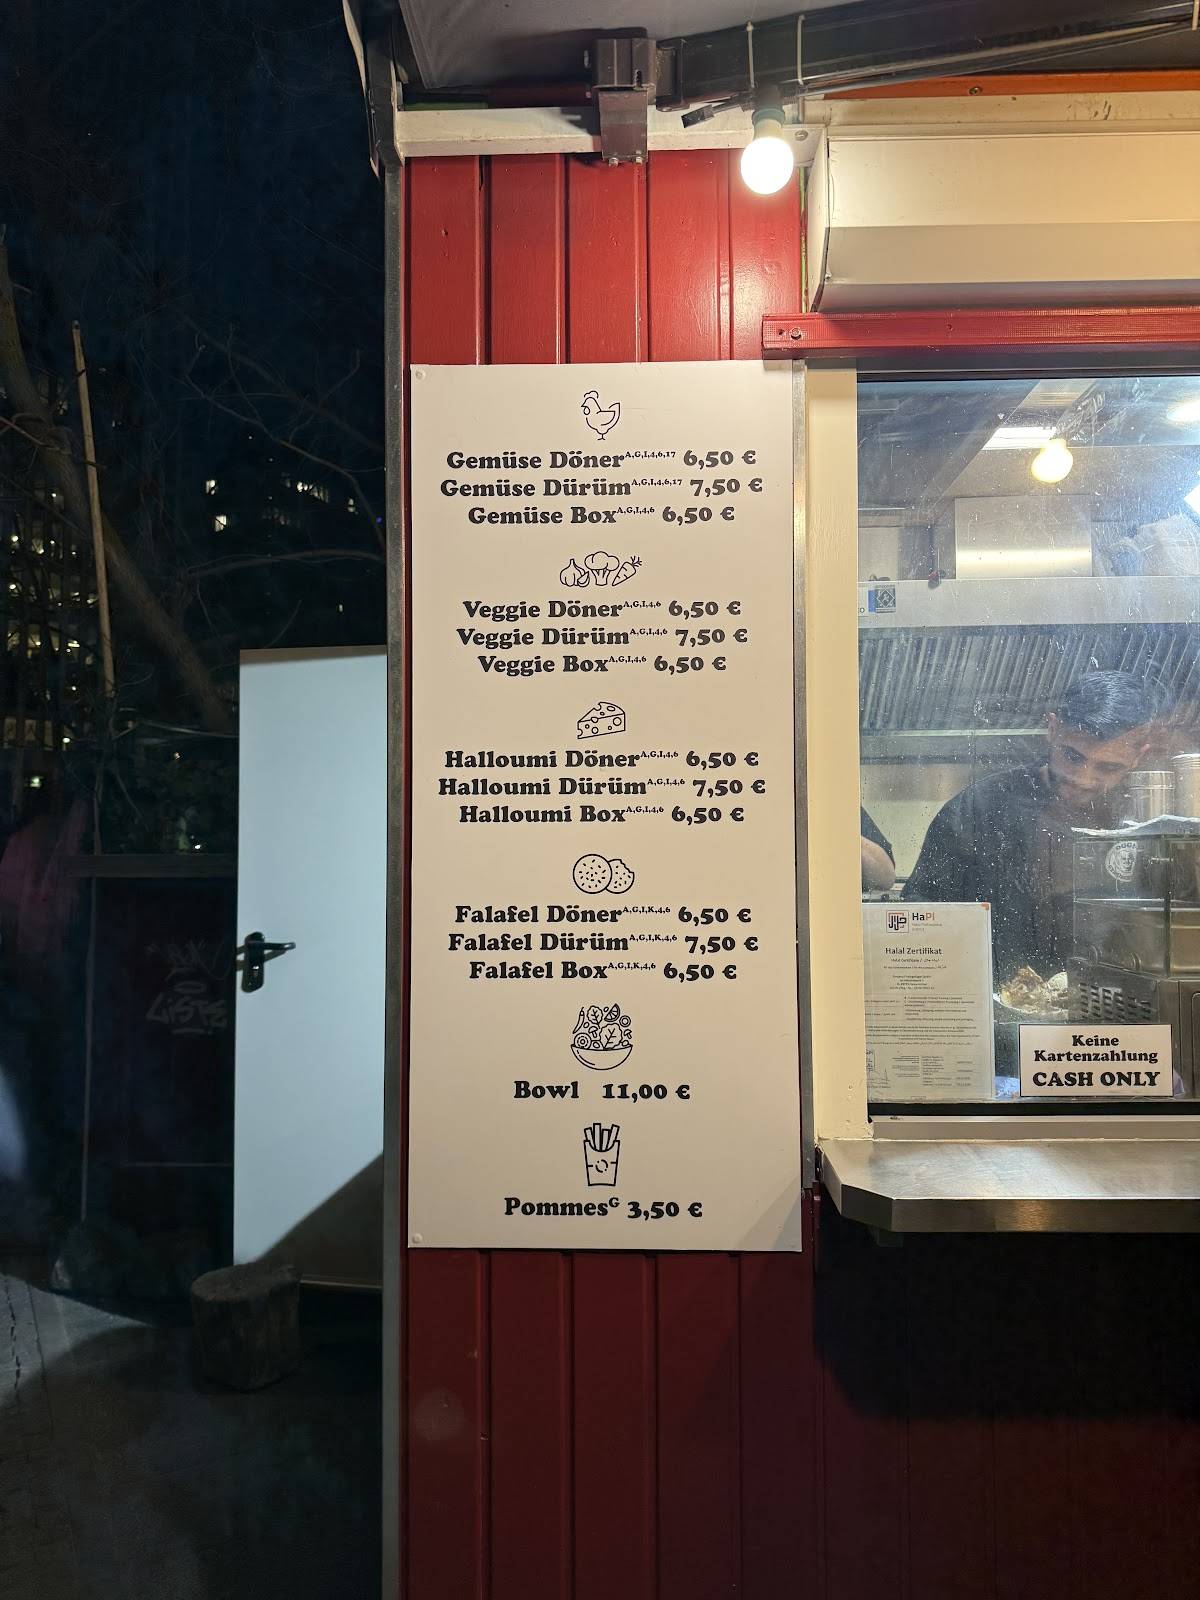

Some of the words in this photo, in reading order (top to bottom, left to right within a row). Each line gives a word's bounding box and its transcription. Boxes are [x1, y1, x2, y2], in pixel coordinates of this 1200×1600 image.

[447, 452, 541, 469] Gemüse
[684, 450, 733, 470] 6,50
[741, 450, 756, 464] €
[441, 479, 535, 496] Gemüse
[690, 479, 740, 497] 7,50
[748, 478, 762, 492] €
[468, 507, 563, 524] Gemüse
[662, 506, 712, 526] 6,50
[720, 507, 734, 521] €
[463, 601, 540, 622] Veggie
[669, 600, 718, 620] 6,50
[726, 601, 741, 615] €
[456, 628, 534, 649] Veggie
[675, 629, 725, 647] 7,50
[733, 629, 747, 643] €
[477, 656, 555, 677] Veggie
[654, 656, 704, 675] 6,50
[712, 656, 726, 670] €
[445, 751, 557, 768] Halloumi
[686, 751, 736, 770] 6,50
[744, 752, 759, 766] €
[438, 778, 551, 795] Halloumi
[693, 780, 743, 798] 7,50
[751, 780, 765, 794] €
[459, 806, 572, 823] Halloumi
[672, 806, 722, 825] 6,50
[730, 808, 744, 822] €
[455, 906, 539, 923] Falafel
[678, 906, 728, 926] 6,50
[737, 908, 751, 923] €
[448, 933, 532, 951] Falafel
[685, 936, 735, 955] 7,50
[744, 936, 758, 951] €
[469, 961, 553, 979] Falafel
[664, 963, 714, 983] 6,50
[722, 965, 736, 979] €
[1072, 1035, 1119, 1046] Keine
[1034, 1050, 1158, 1064] Kartenzahlung
[1033, 1072, 1094, 1086] CASH
[1099, 1072, 1160, 1086] ONLY
[514, 1081, 579, 1099] Bowl
[602, 1084, 667, 1103] 11,00
[675, 1085, 690, 1099] €
[627, 1201, 679, 1221] 3,50
[688, 1202, 702, 1217] €
